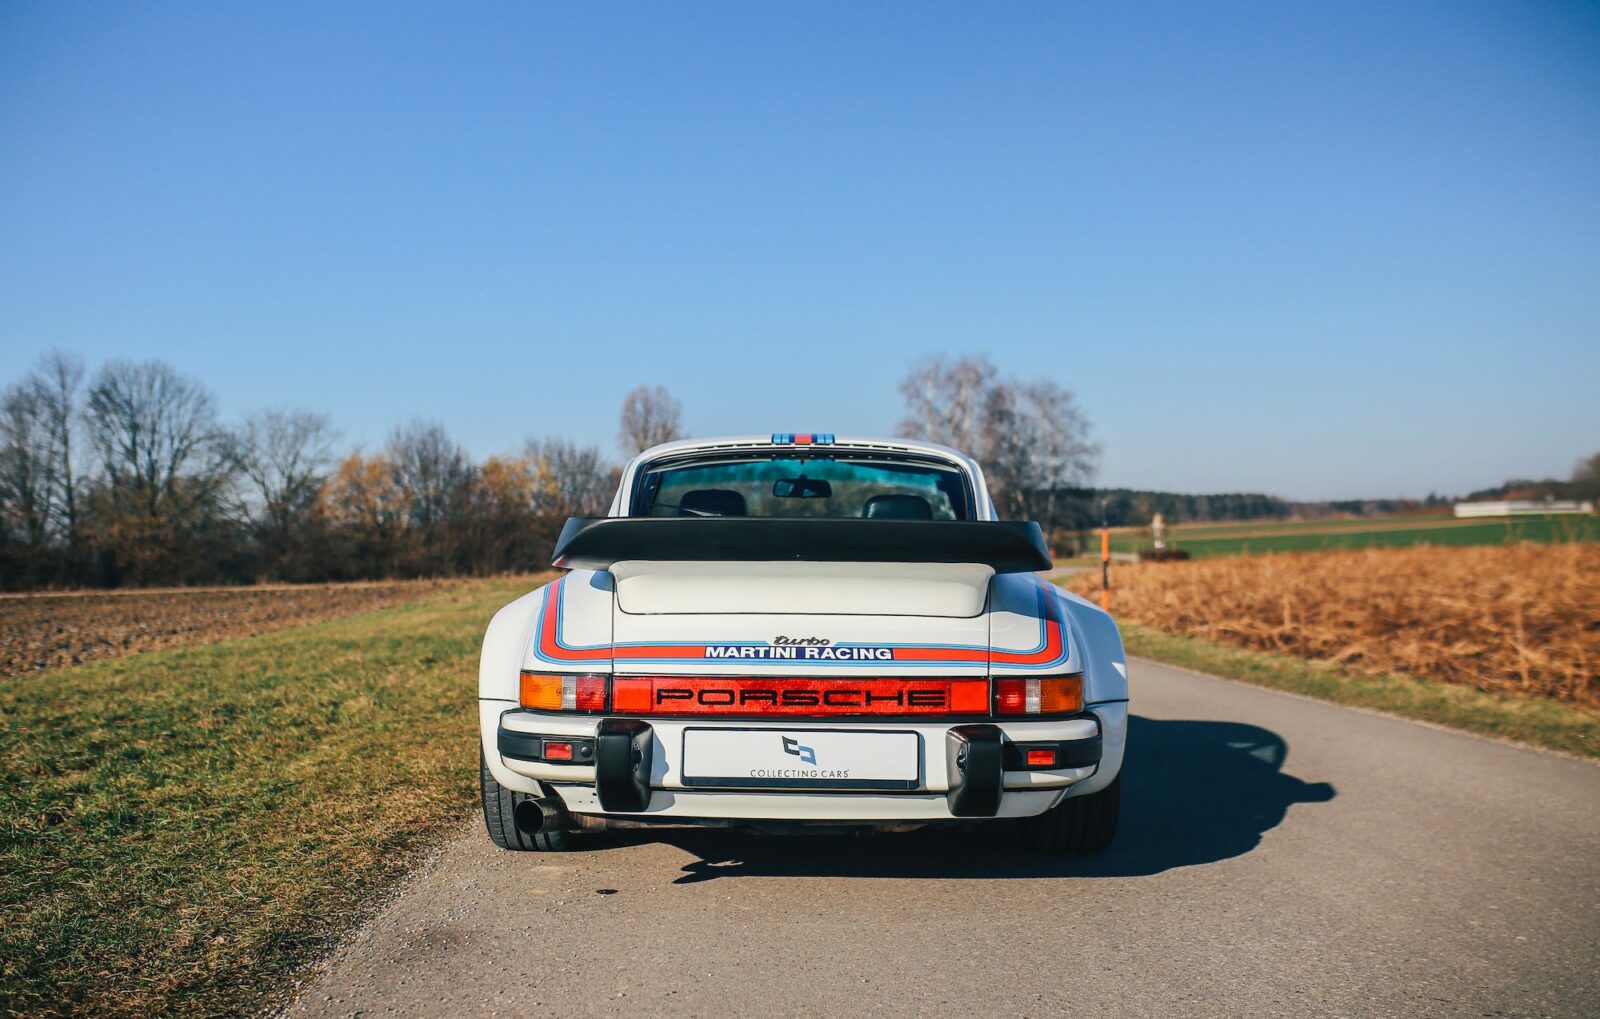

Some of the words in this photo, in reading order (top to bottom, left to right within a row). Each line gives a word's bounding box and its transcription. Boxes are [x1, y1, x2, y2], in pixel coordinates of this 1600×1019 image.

[773, 635, 830, 646] turbo
[705, 646, 796, 659] MARTINI
[805, 647, 892, 660] RACING
[656, 688, 945, 707] PORSCHE
[750, 769, 818, 778] COLLECTING
[820, 769, 849, 778] CARS
